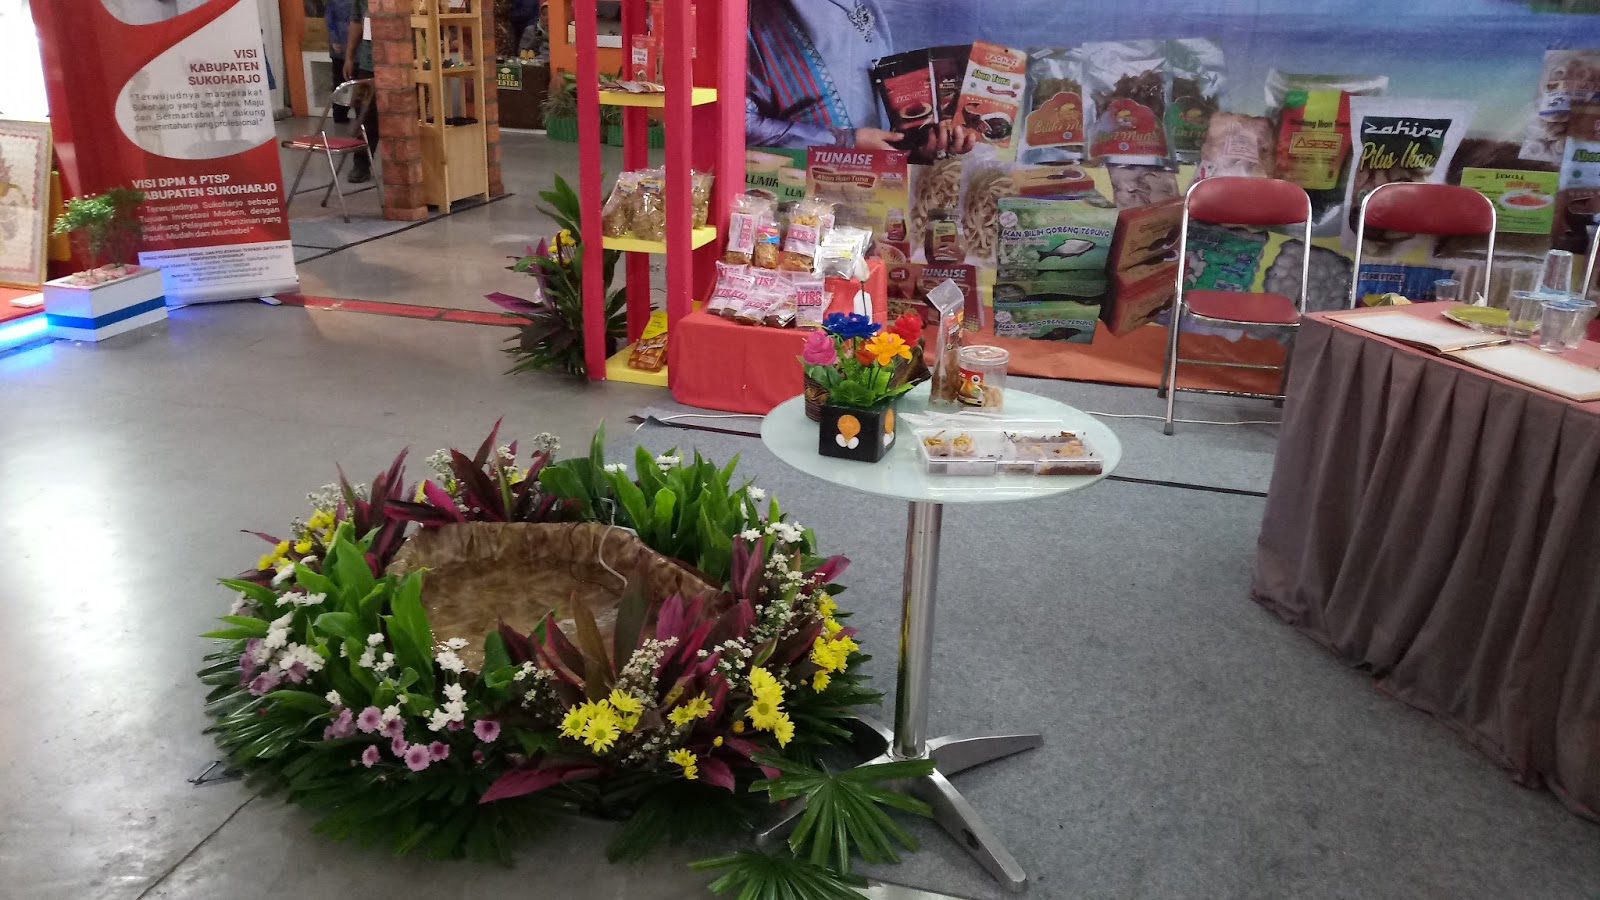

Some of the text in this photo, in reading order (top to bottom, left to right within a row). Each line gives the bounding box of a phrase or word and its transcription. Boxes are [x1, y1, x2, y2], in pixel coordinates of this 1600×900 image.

[234, 49, 258, 59] VISI
[189, 62, 259, 73] KABUPATEN
[188, 74, 261, 86] SUKOHARJO
[177, 102, 198, 111] yang
[244, 99, 264, 108] Maju
[134, 114, 151, 122] dan
[156, 111, 215, 120] Bermartabat
[232, 109, 266, 118] dukung
[194, 121, 214, 131] yang
[815, 151, 874, 166] TUNAISE
[1360, 140, 1436, 172] Pilus Ikan
[132, 174, 230, 189] VISI DPM & PTSP
[142, 183, 277, 201] ABUPATEN SUKOHARJO
[145, 198, 279, 214] Terwujudnya Sukoharjo sebagai
[250, 207, 280, 217] dengan
[181, 219, 223, 230] Pelayanan
[262, 215, 282, 225] yang
[1046, 226, 1079, 235] GORENG
[921, 268, 967, 278] TUNAISE
[797, 291, 822, 305] KISS
